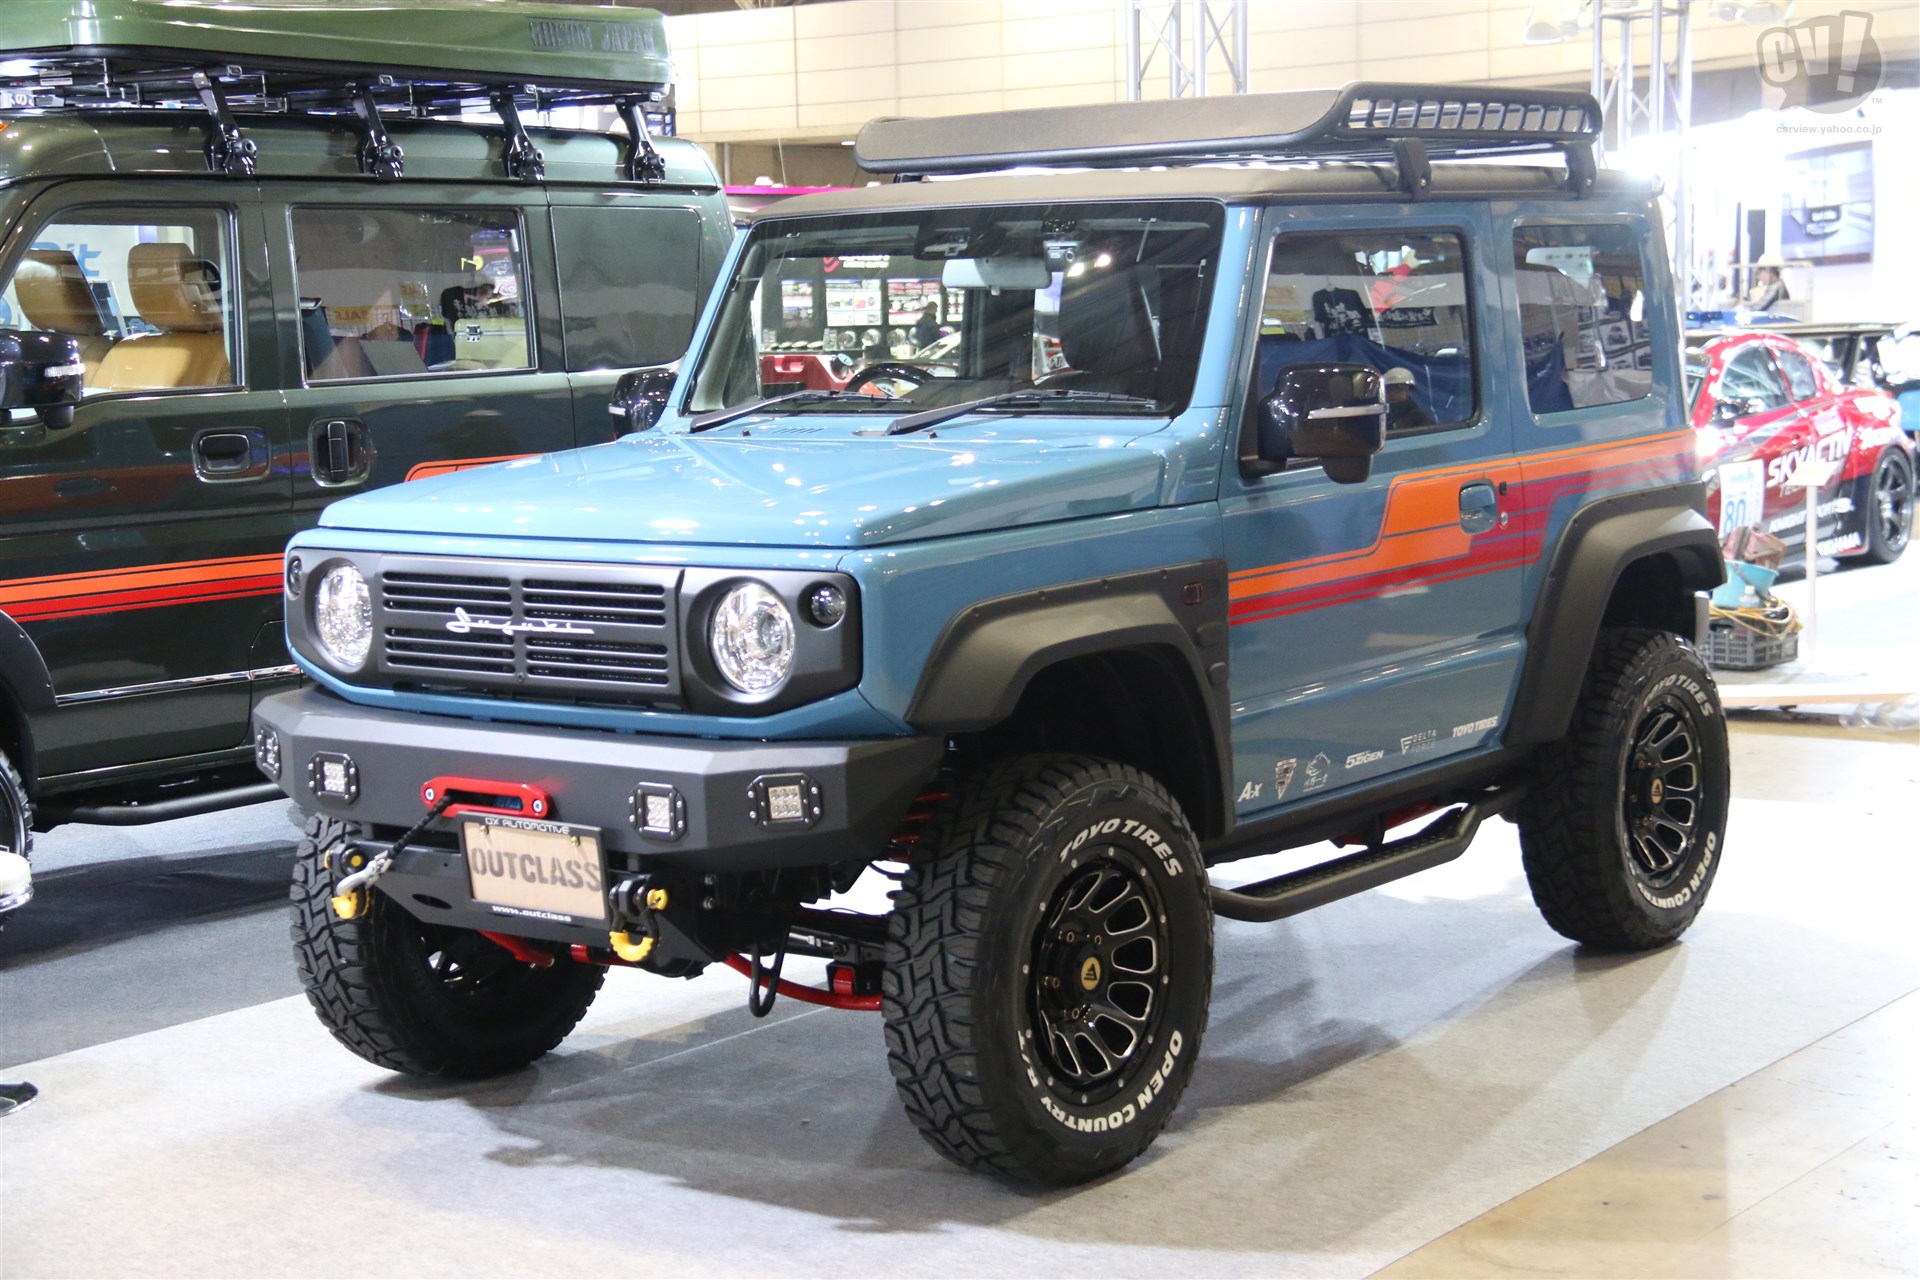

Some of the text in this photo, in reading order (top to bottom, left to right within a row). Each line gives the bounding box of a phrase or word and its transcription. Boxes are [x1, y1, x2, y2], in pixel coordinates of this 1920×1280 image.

[1676, 674, 1714, 717] TIRES
[1452, 722, 1475, 738] TOYO
[502, 819, 571, 835] AUTOMOTIVE
[1059, 817, 1183, 877] TOYO TIRES
[471, 847, 602, 893] OUTCLASS
[1689, 831, 1717, 892] OPEN
[492, 905, 572, 923] www.outclass
[1136, 1029, 1183, 1110] OPEN
[1040, 1096, 1136, 1133] COUNTRY
